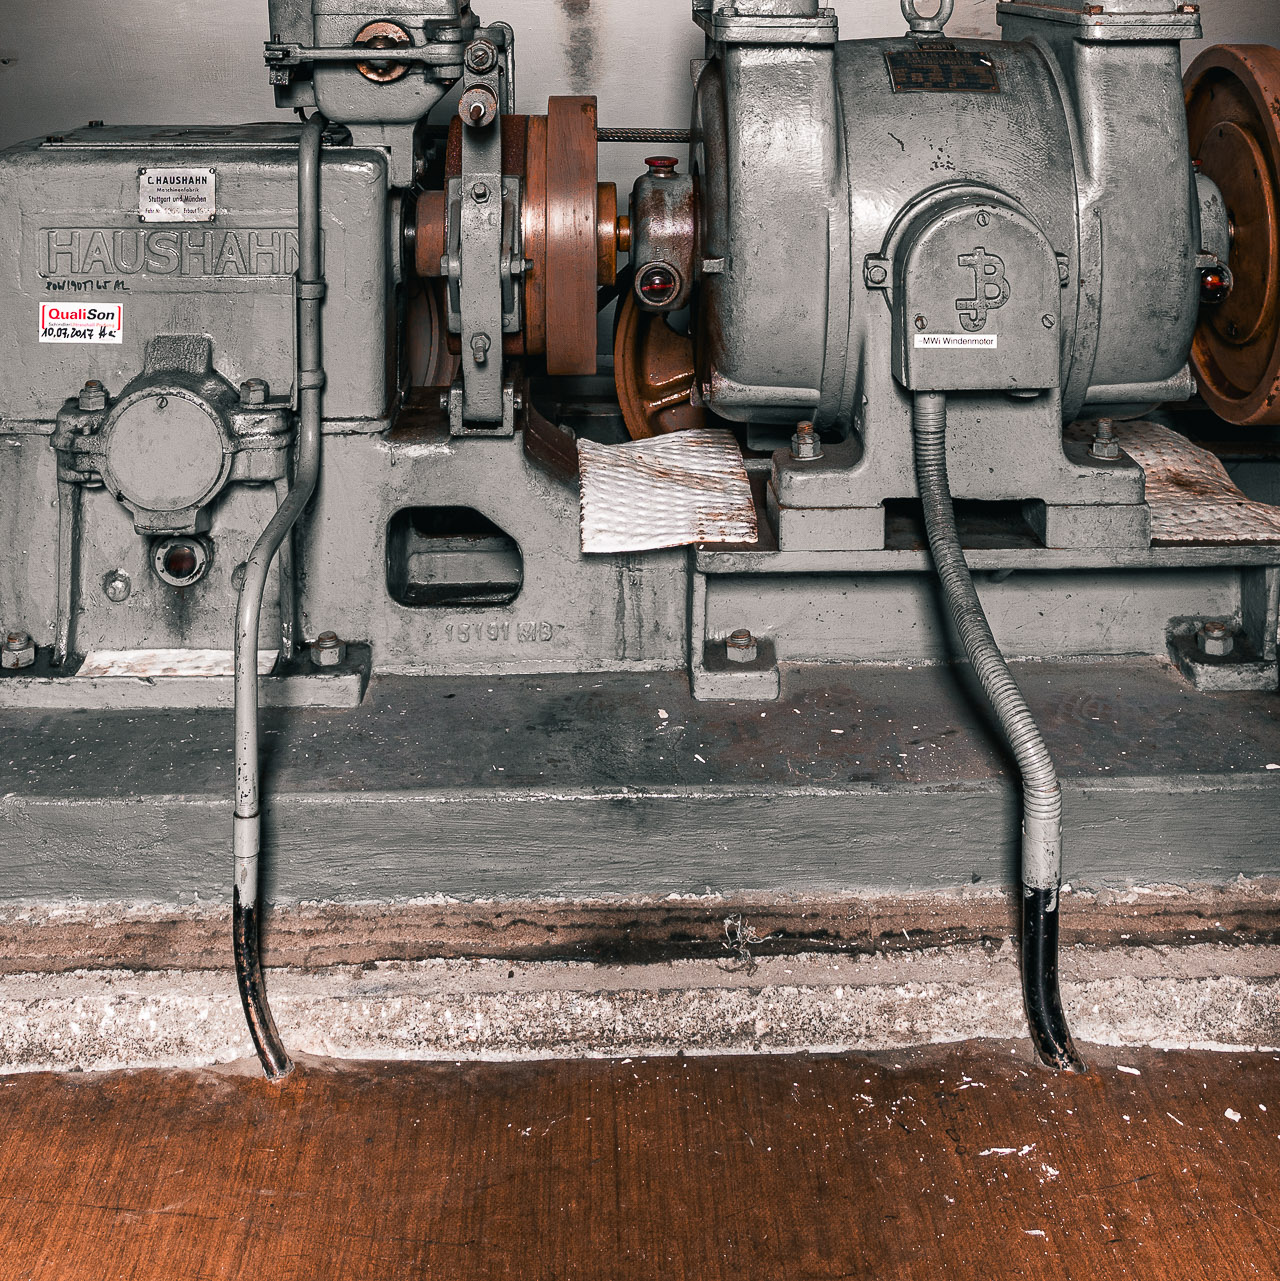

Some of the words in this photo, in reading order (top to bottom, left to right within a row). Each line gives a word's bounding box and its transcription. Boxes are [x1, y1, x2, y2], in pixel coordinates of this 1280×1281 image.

[156, 176, 208, 185] HAUSHAHN
[148, 195, 171, 204] Stuttgart
[184, 195, 207, 203] München
[48, 308, 115, 320] QualiSon
[942, 337, 994, 345] Windenmotor
